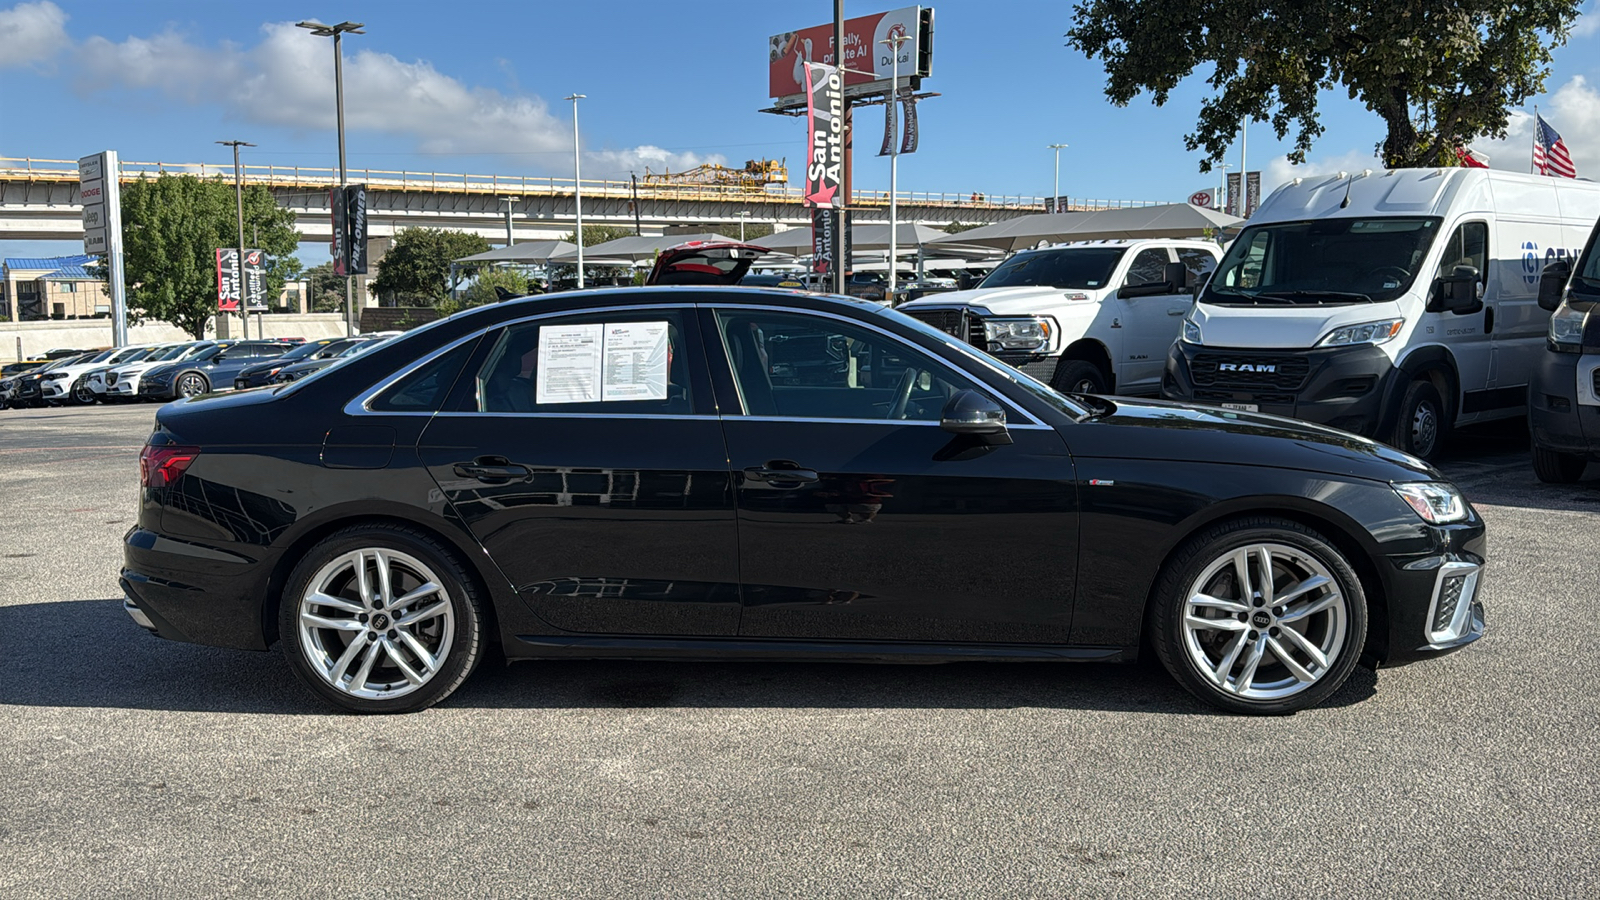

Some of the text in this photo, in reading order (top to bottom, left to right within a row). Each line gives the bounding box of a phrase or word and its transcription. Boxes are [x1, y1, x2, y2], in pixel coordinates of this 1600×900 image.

[829, 33, 862, 48] Fally,
[857, 44, 867, 57] AI
[881, 52, 909, 66] Duk.ai
[826, 73, 841, 185] Antonio
[809, 130, 827, 181] San
[81, 187, 101, 199] DODGE
[85, 209, 98, 225] Jeep
[88, 236, 103, 245] RAM
[352, 190, 366, 270] PRE-OWNED
[821, 210, 832, 261] Antonio
[334, 228, 342, 260] San
[814, 237, 823, 261] San
[229, 252, 240, 300] Antonio
[249, 269, 257, 304] certified
[219, 277, 230, 300] San
[1219, 363, 1276, 373] RAM
